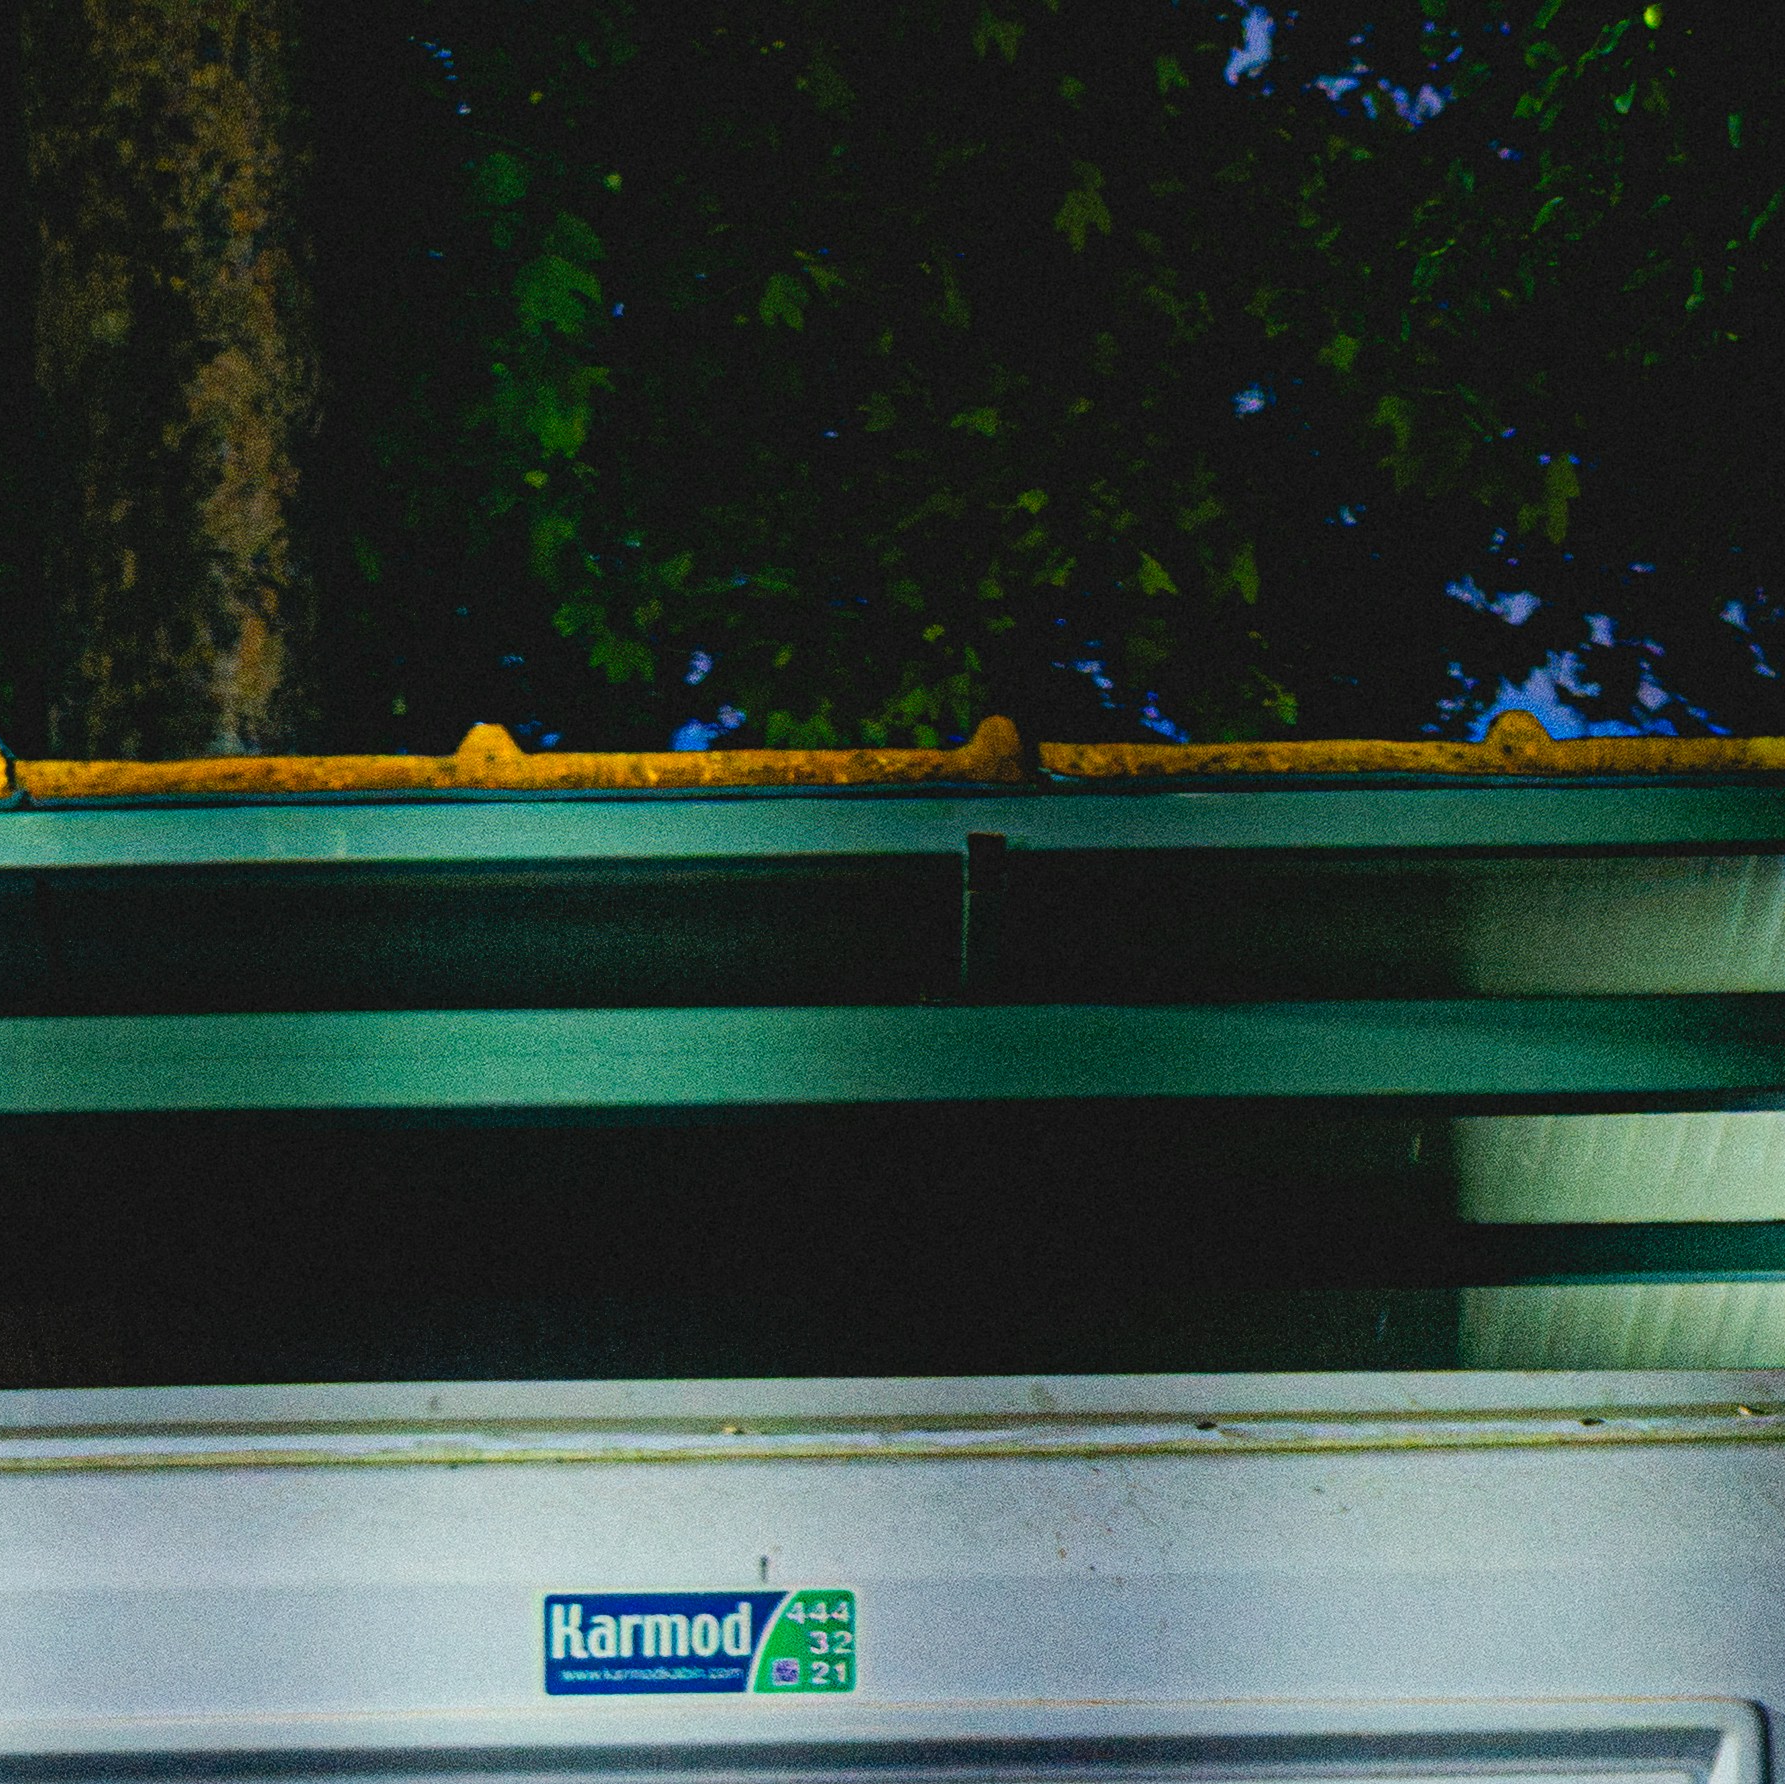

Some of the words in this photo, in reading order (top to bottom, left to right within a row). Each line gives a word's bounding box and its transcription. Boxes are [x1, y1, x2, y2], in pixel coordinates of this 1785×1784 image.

[786, 1602, 849, 1624] 444
[550, 1602, 753, 1659] Karmod
[810, 1630, 853, 1655] 32
[812, 1661, 846, 1684] 21
